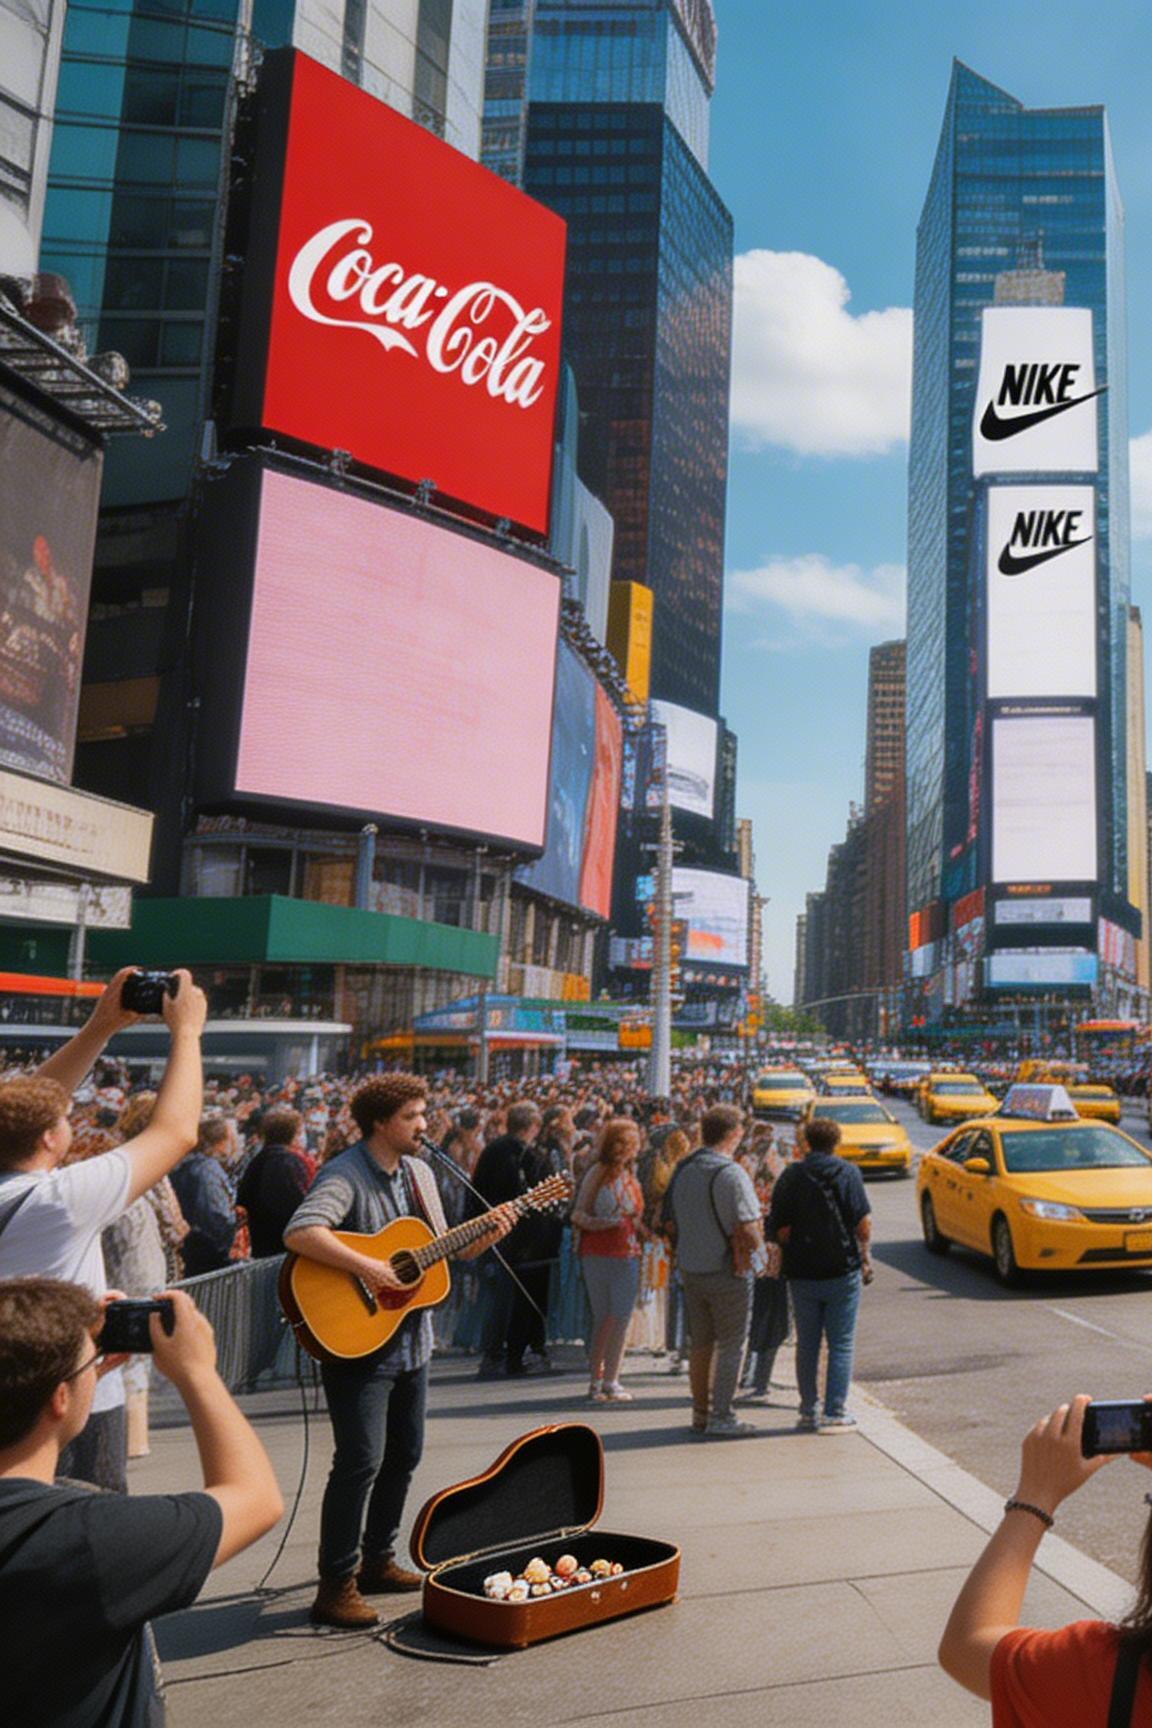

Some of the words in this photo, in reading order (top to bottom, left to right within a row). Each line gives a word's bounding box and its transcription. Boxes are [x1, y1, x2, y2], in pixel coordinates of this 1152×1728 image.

[288, 219, 552, 409] Coca-Cola
[998, 363, 1081, 406] NIKE
[1011, 510, 1083, 547] NIKE
